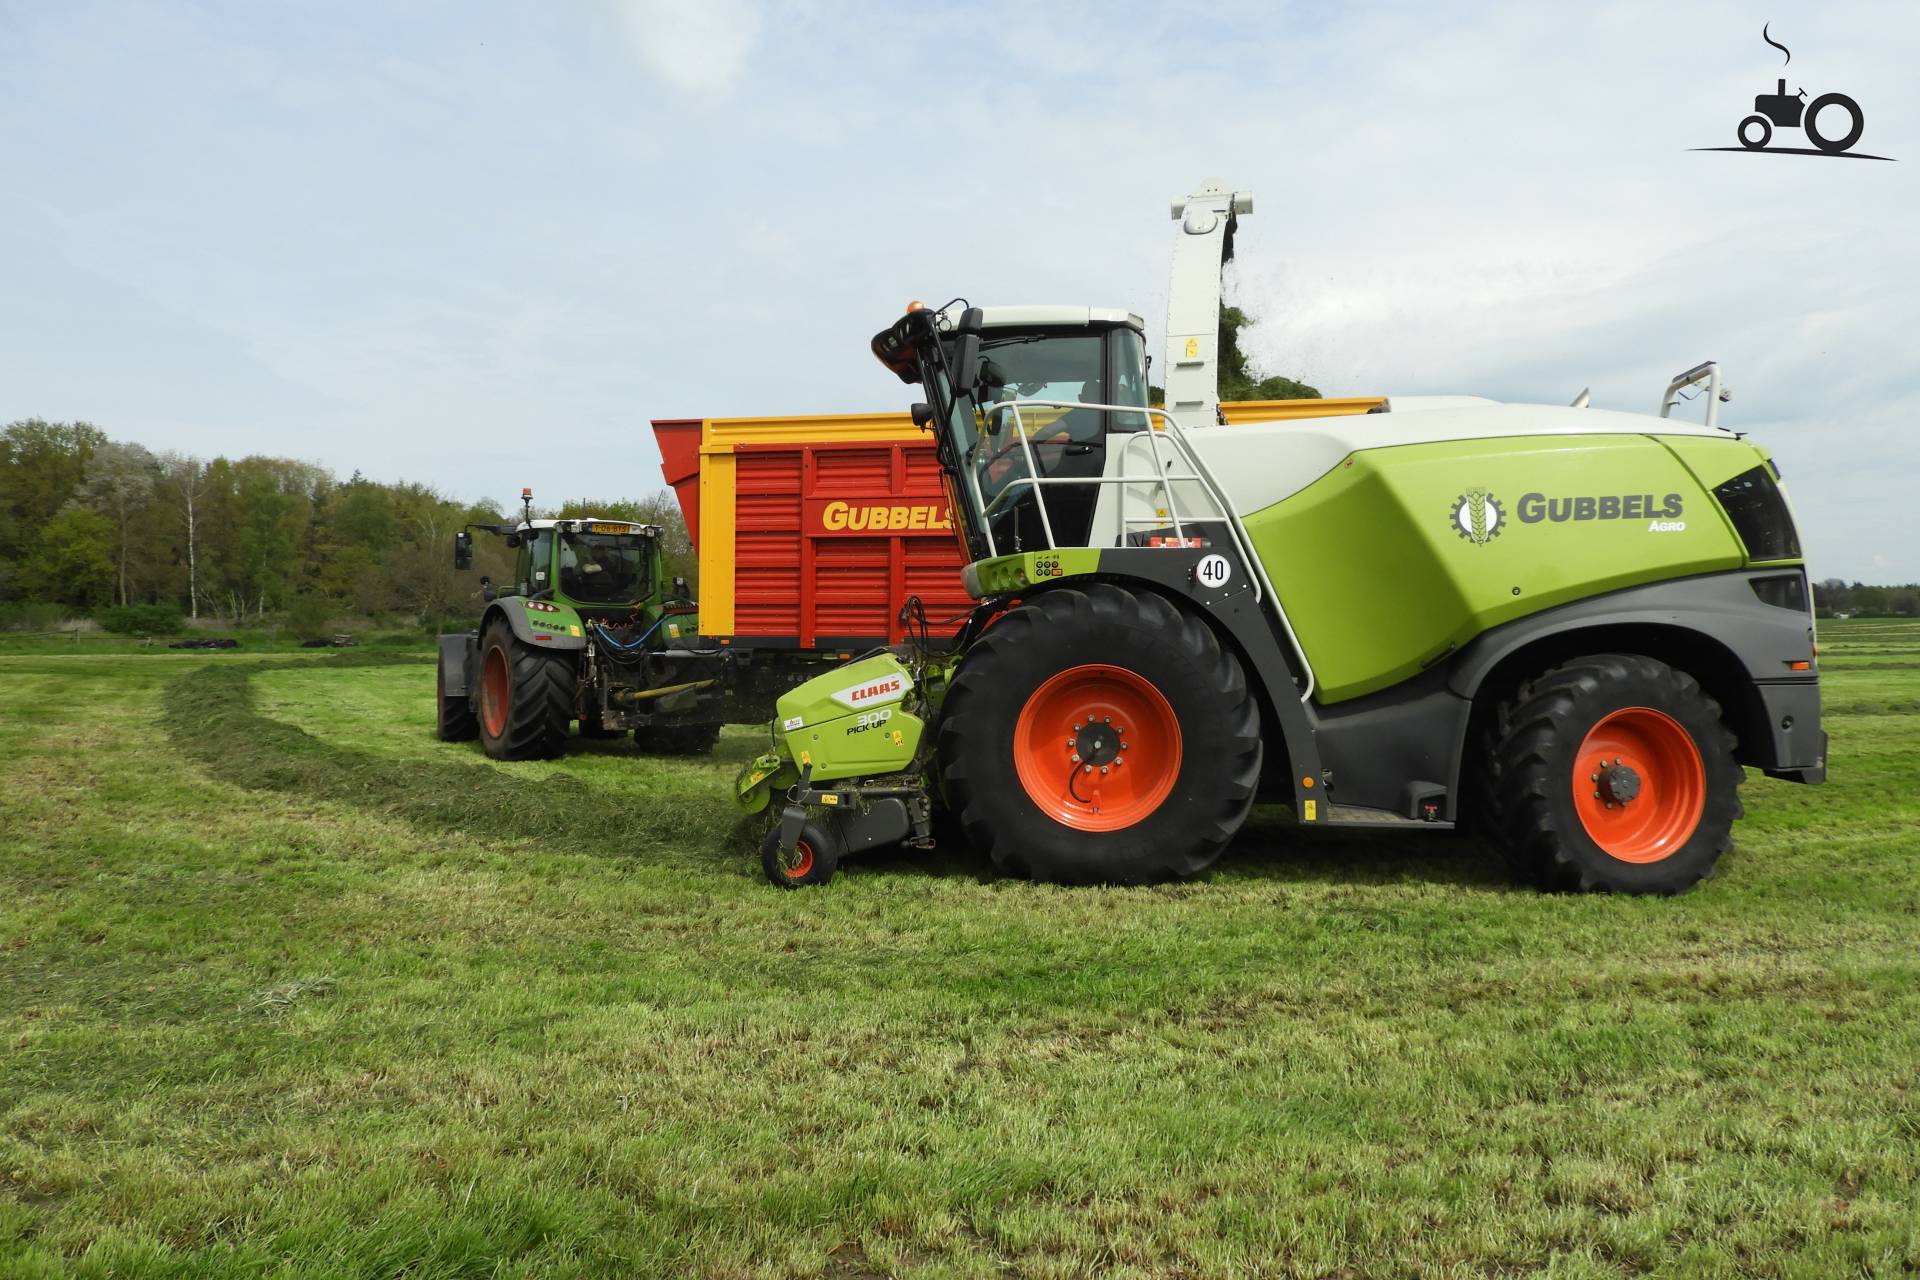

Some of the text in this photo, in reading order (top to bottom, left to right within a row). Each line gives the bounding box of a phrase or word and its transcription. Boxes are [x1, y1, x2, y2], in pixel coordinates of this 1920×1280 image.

[1517, 492, 1683, 524] GUBBELS
[1648, 520, 1686, 532] AGRO
[1203, 560, 1224, 581] 40
[851, 680, 900, 702] CLAAS
[846, 719, 887, 736] PICK UP
[857, 709, 892, 727] 300
